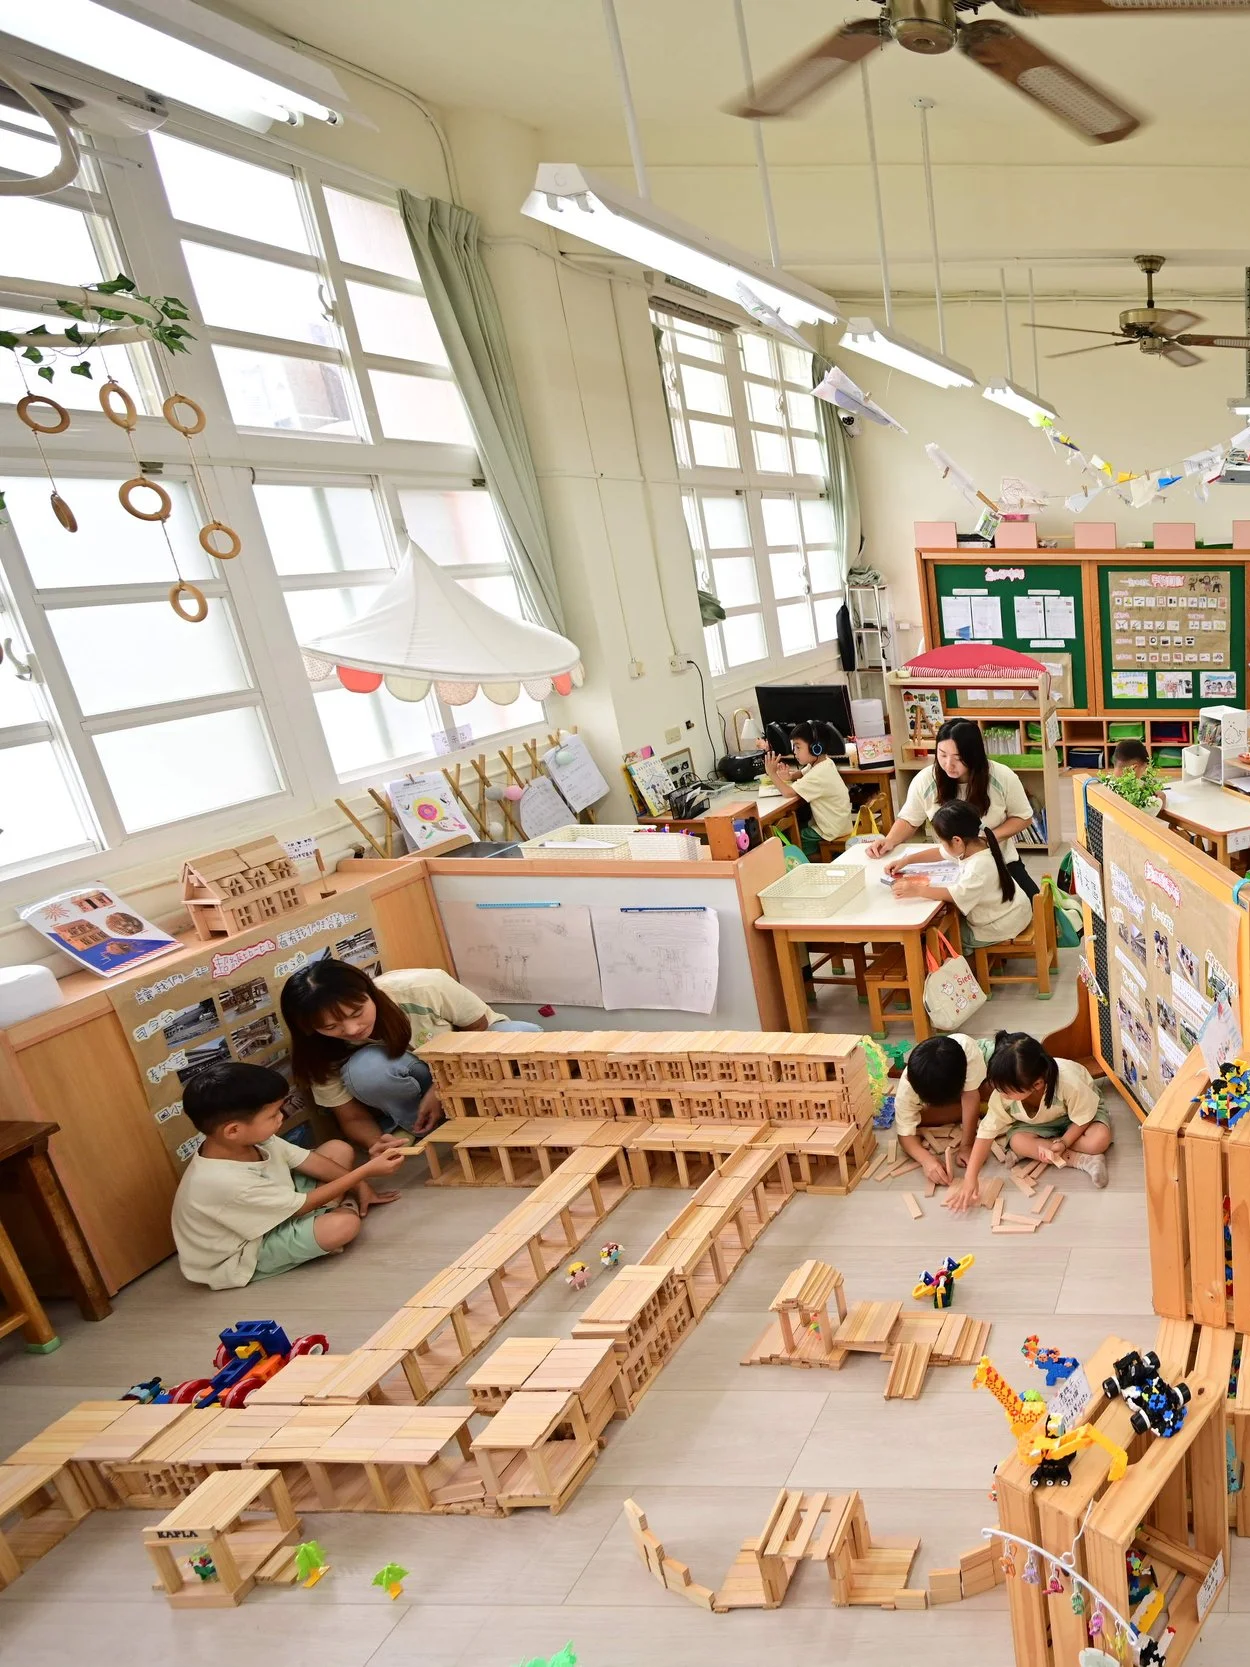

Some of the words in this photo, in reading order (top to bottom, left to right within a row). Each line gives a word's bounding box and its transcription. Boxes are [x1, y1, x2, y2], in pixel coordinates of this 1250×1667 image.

[136, 1011, 174, 1040] 司令台
[156, 1530, 198, 1538] KAPLA
